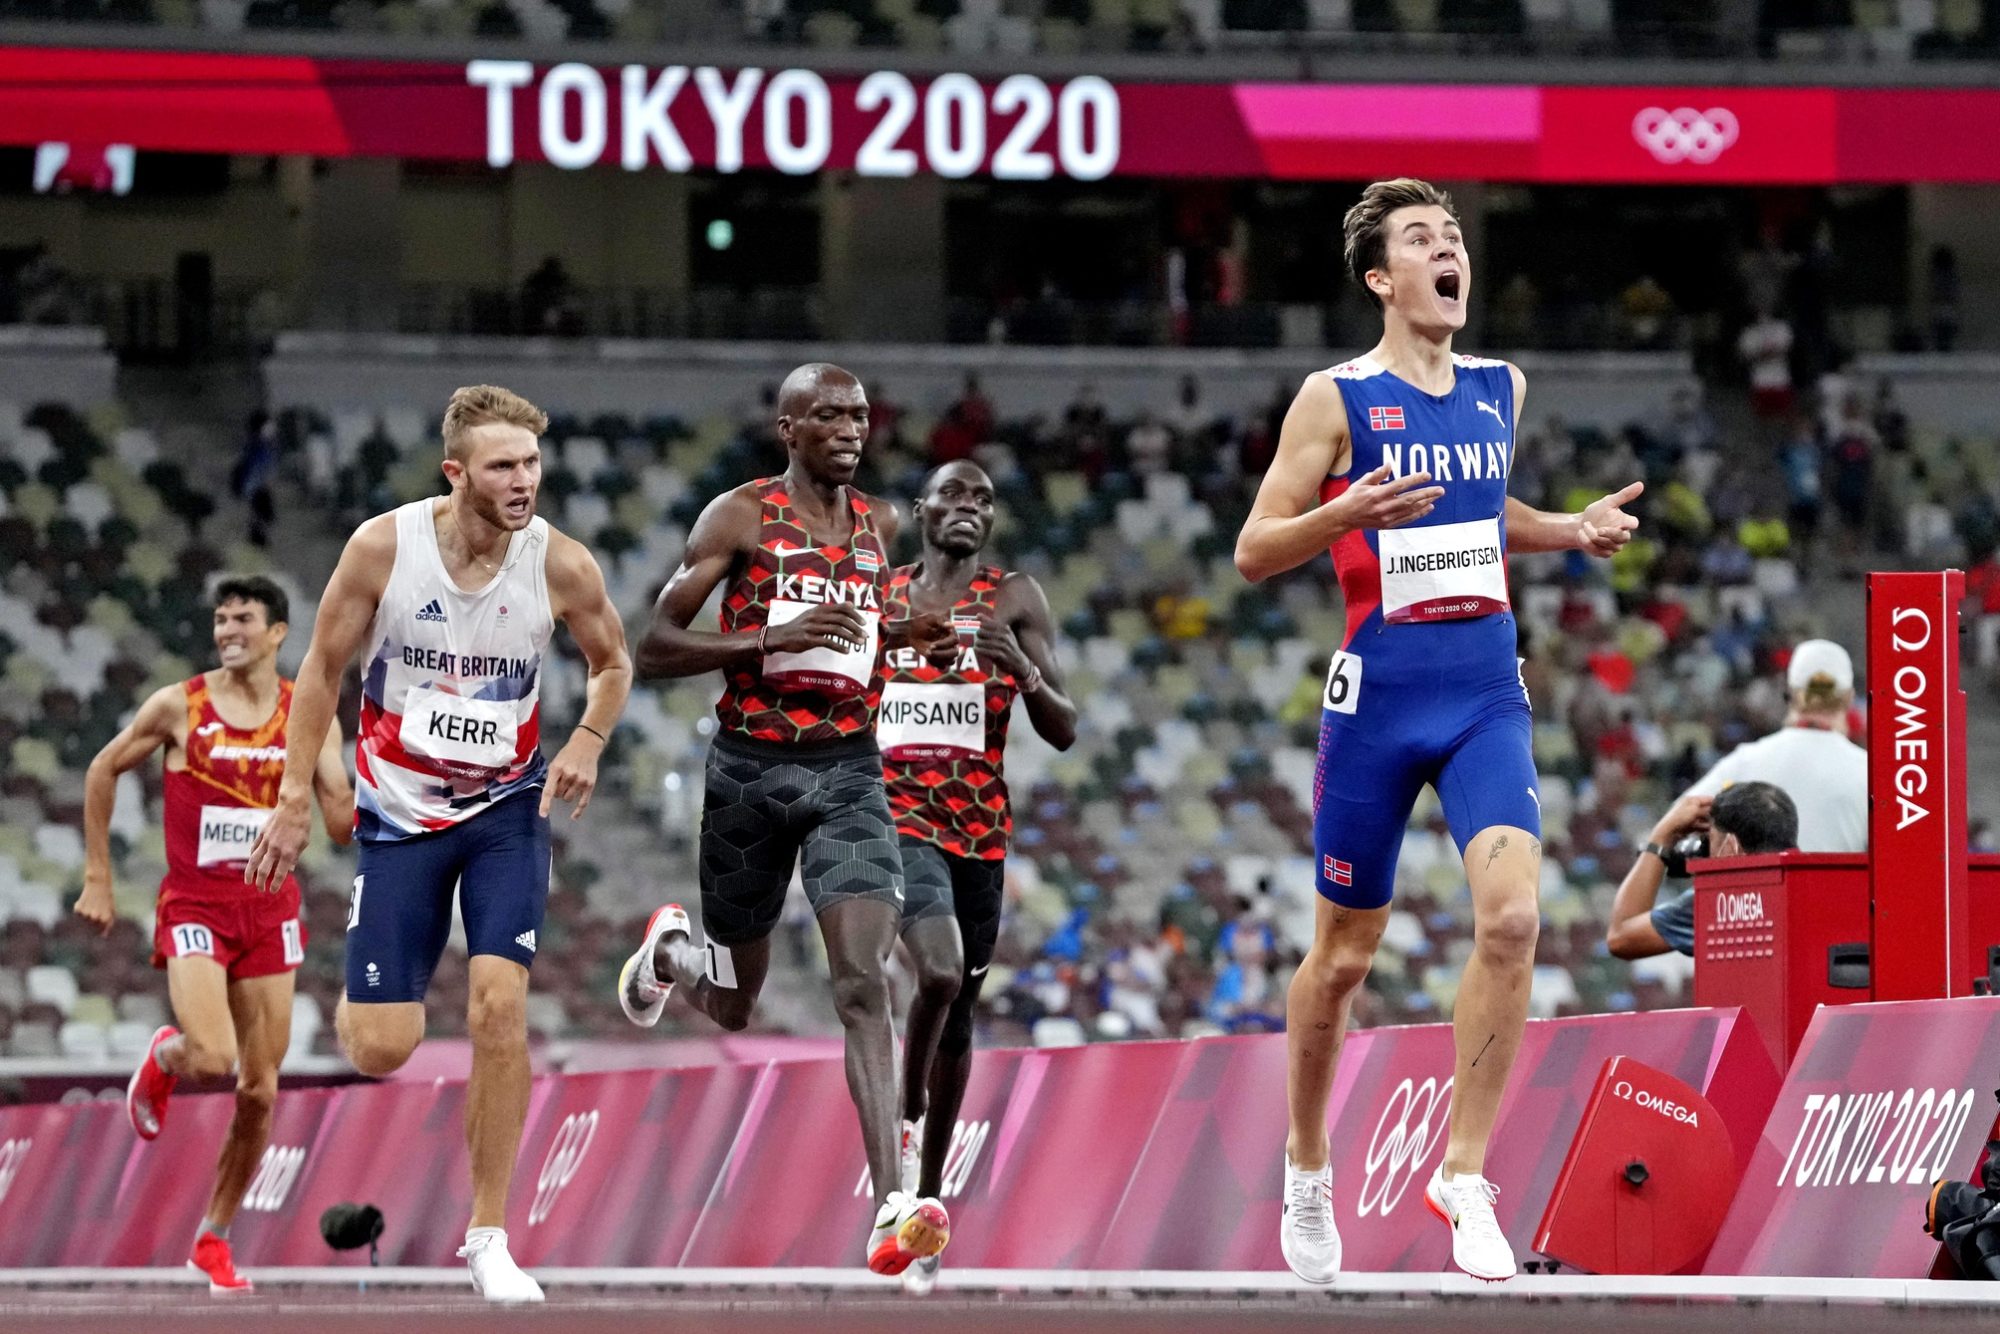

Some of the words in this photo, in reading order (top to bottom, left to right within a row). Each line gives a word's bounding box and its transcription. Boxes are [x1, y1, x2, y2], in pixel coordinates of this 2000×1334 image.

[466, 60, 832, 175] TOKYO
[854, 70, 1121, 181] 2020
[1382, 442, 1507, 482] NORWAY
[1386, 546, 1499, 574] J.INGEBRIGTSEN
[777, 573, 879, 609] KENYA
[415, 612, 447, 623] adidas
[1424, 606, 1445, 614] TOKYO
[1445, 604, 1460, 612] 2020
[403, 645, 456, 675] GREAT
[461, 655, 527, 679] BRITAIN
[1328, 658, 1349, 705] 6
[428, 710, 497, 745] KERR
[881, 700, 980, 725] KIPSANG
[1893, 666, 1930, 831] OMEGA
[1728, 892, 1764, 922] OMEGA
[178, 927, 208, 951] 10
[1635, 1091, 1698, 1128] OMEGA
